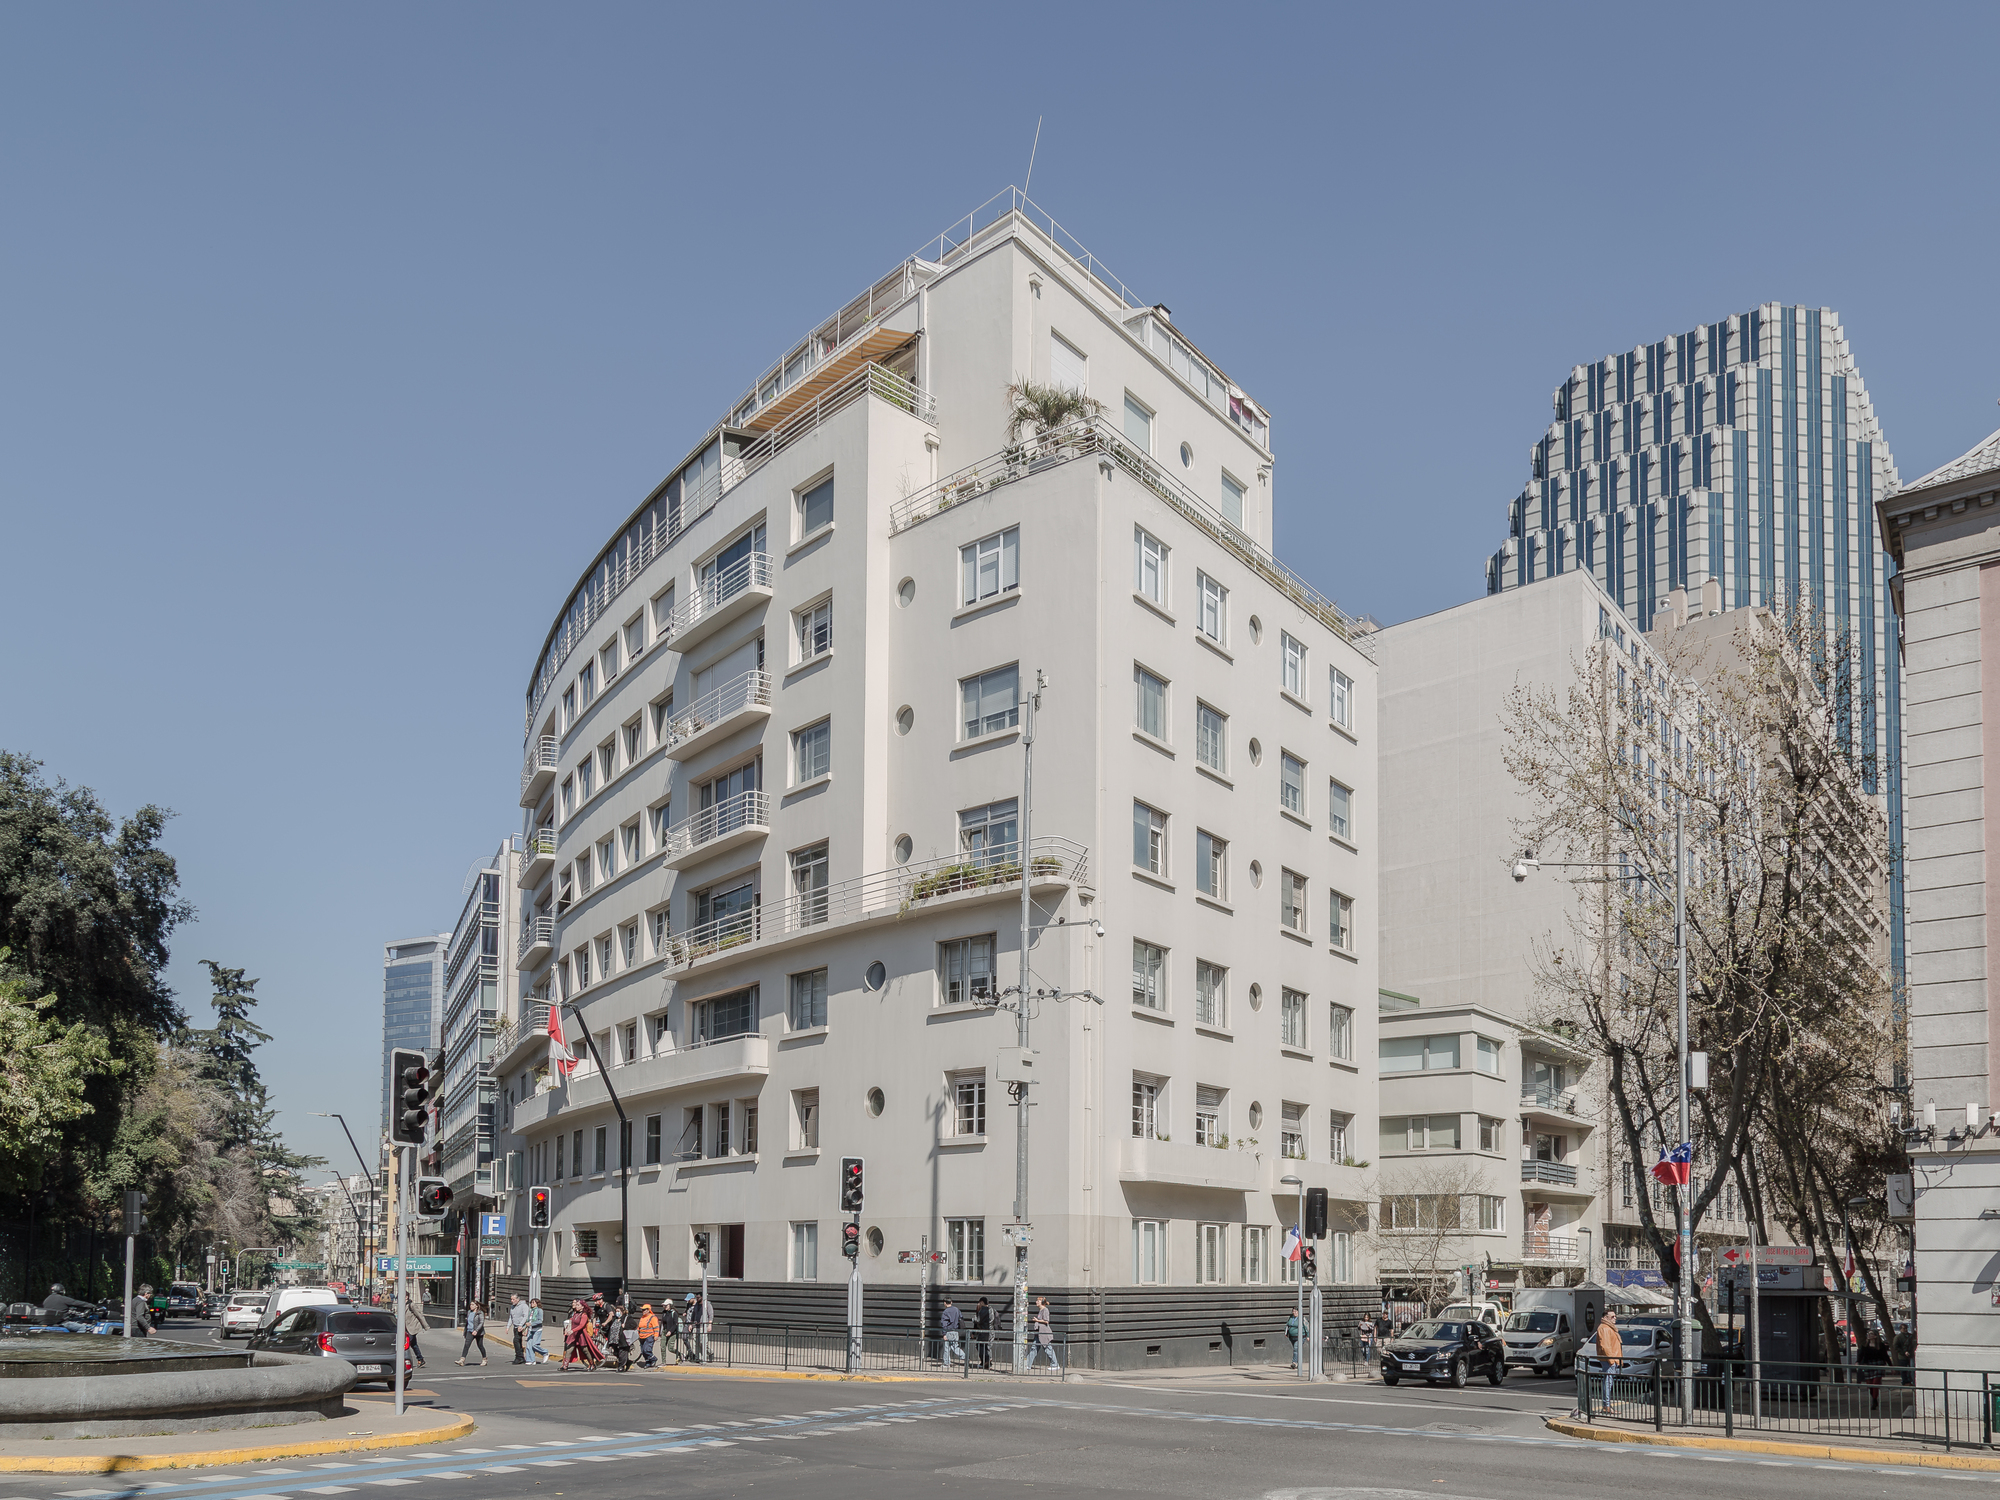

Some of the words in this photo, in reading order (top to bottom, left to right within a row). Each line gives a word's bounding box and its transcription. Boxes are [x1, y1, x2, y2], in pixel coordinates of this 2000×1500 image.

[488, 1216, 501, 1235] E
[482, 1237, 500, 1245] saba
[381, 1259, 389, 1270] E
